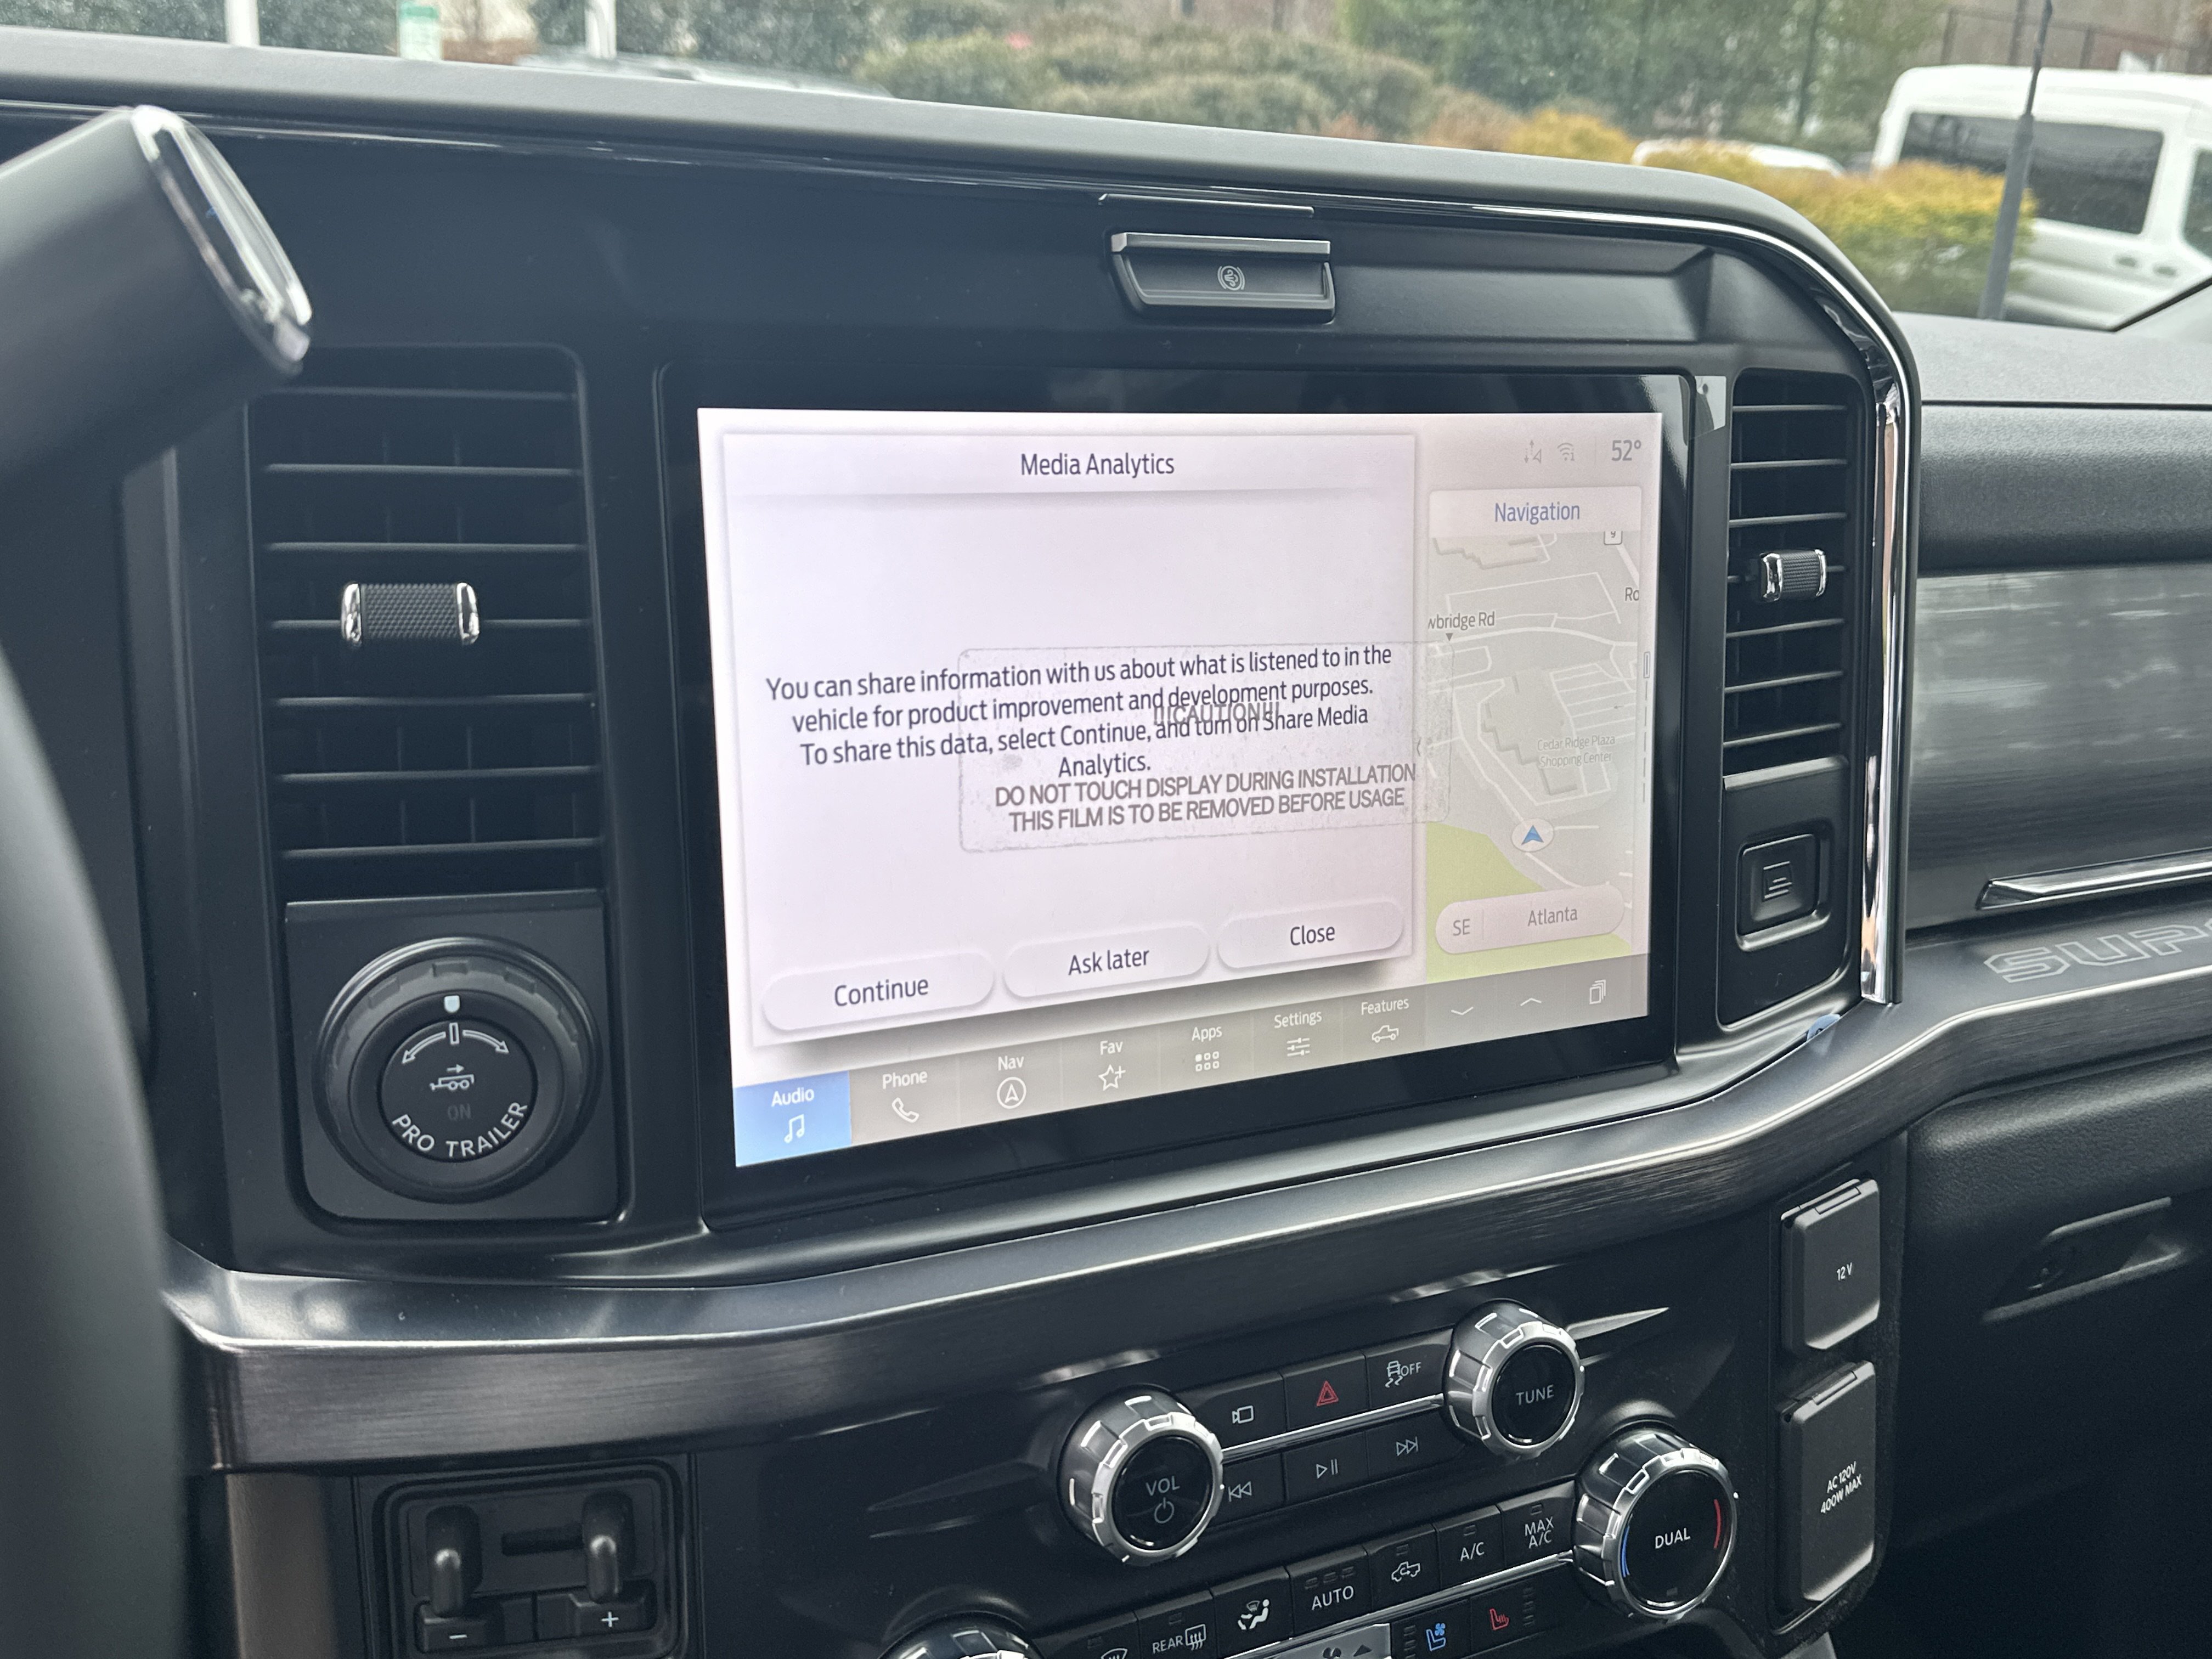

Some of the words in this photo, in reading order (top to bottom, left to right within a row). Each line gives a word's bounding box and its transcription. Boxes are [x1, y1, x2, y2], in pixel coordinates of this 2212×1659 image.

[1611, 439, 1641, 461] 52°
[1020, 453, 1080, 476] Media
[1086, 452, 1175, 478] Analytics
[1495, 501, 1580, 524] Navigation
[1479, 611, 1495, 627] Rd
[766, 678, 808, 701] You
[815, 679, 852, 698] can
[857, 672, 915, 696] share
[921, 666, 1041, 692] information
[1046, 661, 1089, 685] with
[1095, 664, 1115, 681] us
[1120, 658, 1175, 680] about
[1180, 654, 1226, 676] what
[1231, 654, 1244, 673] is
[1249, 648, 1318, 672] listened
[1323, 649, 1340, 667] to
[1344, 647, 1359, 666] in
[1364, 645, 1392, 664] the
[792, 707, 868, 733] vehicle
[873, 705, 903, 727] for
[909, 701, 988, 730] product
[993, 692, 1124, 721] improvement
[1128, 687, 1163, 710] and
[1169, 681, 1287, 708] development
[1291, 679, 1373, 703] purposes.
[801, 743, 827, 765] To
[833, 740, 891, 764] share
[896, 736, 935, 758] this
[941, 733, 993, 755] data,
[998, 727, 1056, 751] select
[1060, 721, 1151, 746] Continue,
[1156, 716, 1190, 739] and
[1195, 716, 1232, 736] turn
[1237, 717, 1259, 733] on
[1264, 708, 1312, 731] Share
[1318, 706, 1368, 727] Media
[1537, 739, 1563, 751] Cedar
[1565, 736, 1589, 750] Ridge
[1592, 735, 1616, 746] Plaza
[1059, 754, 1151, 777] Analytics.
[1540, 754, 1582, 768] Shopping
[1584, 752, 1612, 764] Center
[996, 786, 1024, 806] DO
[1030, 783, 1071, 804] NOT
[1075, 778, 1141, 803] TOUCH
[1147, 775, 1222, 798] DISPLAY
[1226, 771, 1294, 793] DURING
[1298, 763, 1417, 788] INSTALLATION
[1009, 810, 1053, 832] THIS
[1058, 807, 1103, 829] FILM
[1108, 805, 1124, 825] IS
[1128, 804, 1154, 823] TO
[1159, 802, 1182, 821] BE
[1187, 796, 1273, 820] REMOVED
[1278, 791, 1345, 813] BEFORE
[1349, 787, 1404, 808] USAGE
[1528, 907, 1578, 926] Atlanta
[1290, 925, 1335, 946] Close
[1453, 919, 1470, 936] SE
[1983, 918, 2212, 983] SUP
[1068, 953, 1102, 976] Ask
[1107, 949, 1150, 970] later
[834, 978, 929, 1007] Continue
[1361, 996, 1409, 1015] Features
[1274, 1010, 1322, 1030] Settings
[1192, 1025, 1222, 1042] Apps
[1100, 1040, 1123, 1055] Fav
[998, 1056, 1024, 1071] Nav
[882, 1070, 928, 1090] Phone
[771, 1086, 815, 1107] Audio
[447, 1104, 471, 1120] ON
[392, 1114, 436, 1152] PRO
[446, 1102, 528, 1158] TRAILER
[1401, 1361, 1421, 1376] OFF
[1516, 1385, 1554, 1405] TUNE
[1146, 1476, 1180, 1496] VOL
[1826, 1475, 1838, 1493] AC
[1838, 1460, 1857, 1484] 120V
[1820, 1487, 1844, 1514] 400W
[1844, 1473, 1862, 1497] MAX
[1524, 1516, 1554, 1536] MAX
[1528, 1529, 1552, 1549] A/C
[1655, 1528, 1691, 1549] DUAL
[1460, 1542, 1485, 1562] A/C
[1311, 1585, 1355, 1610] AUTO
[1152, 1634, 1183, 1654] REAR
